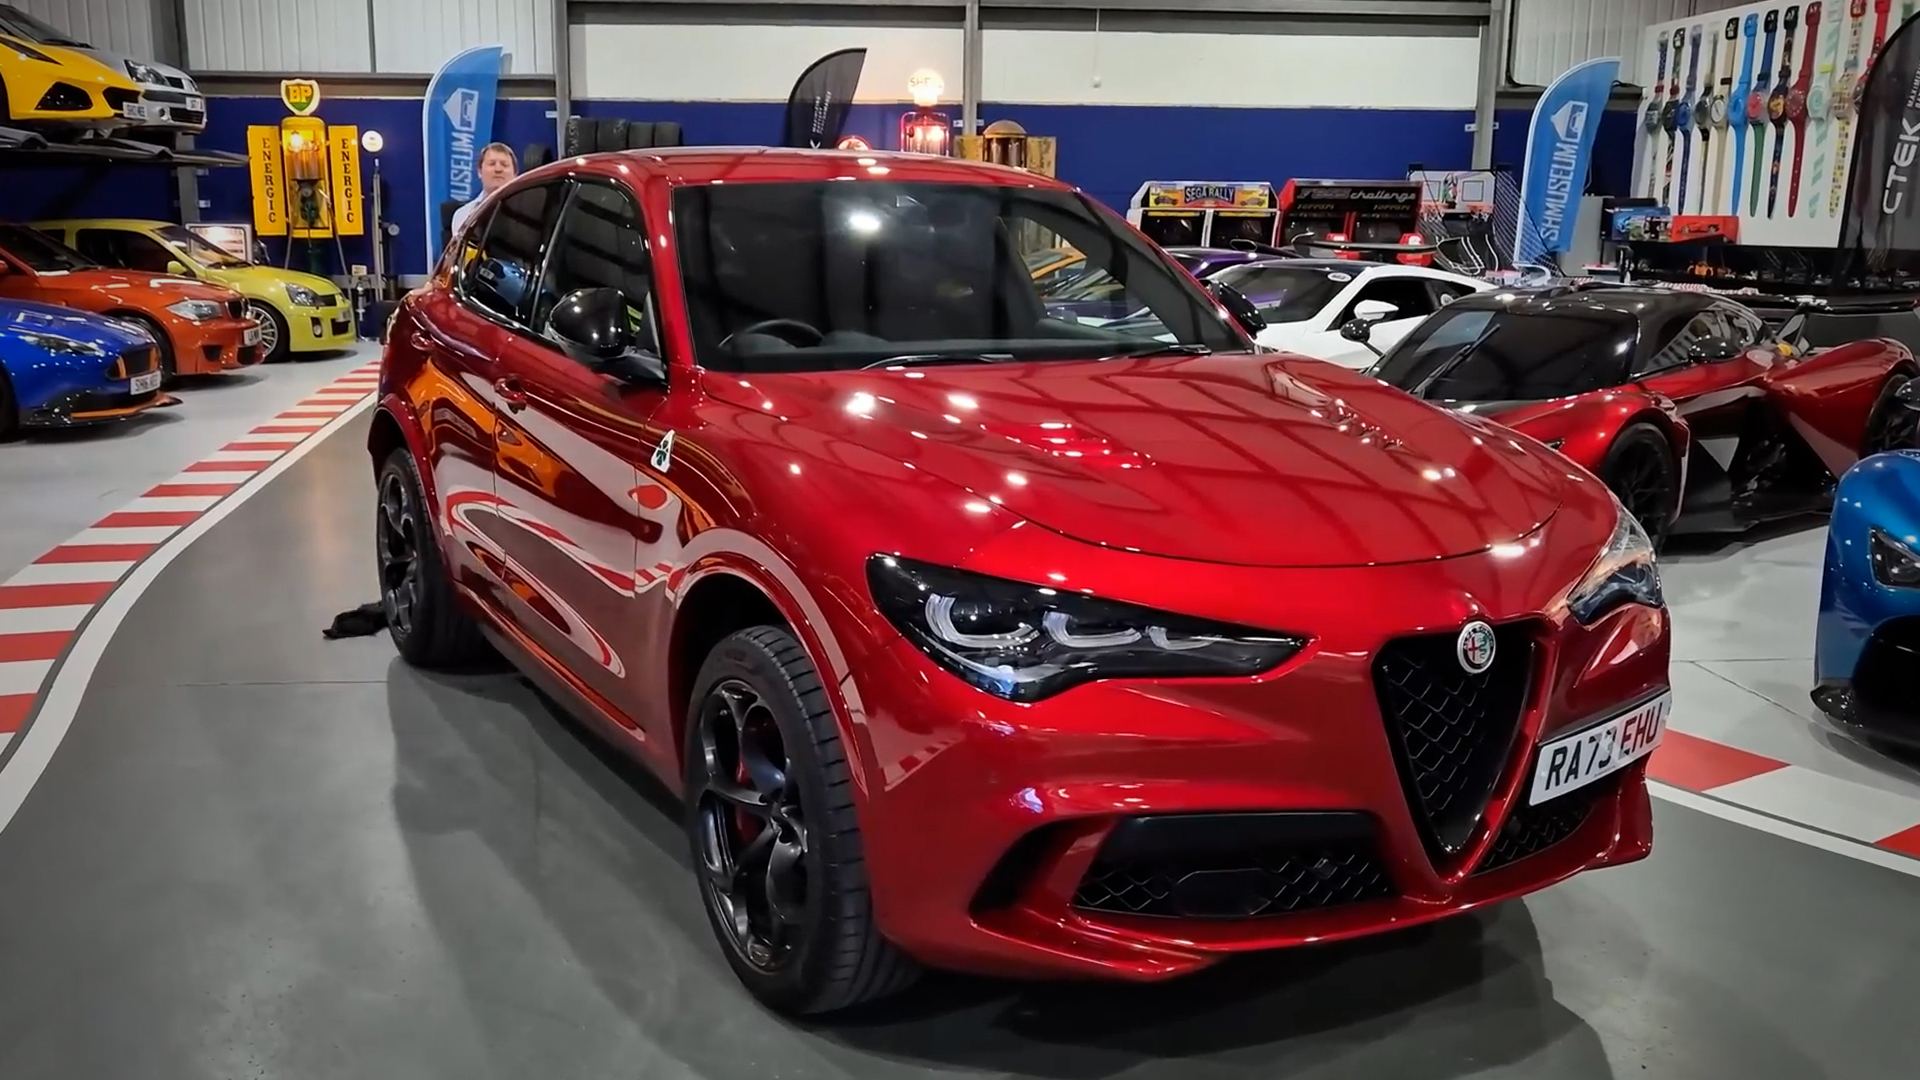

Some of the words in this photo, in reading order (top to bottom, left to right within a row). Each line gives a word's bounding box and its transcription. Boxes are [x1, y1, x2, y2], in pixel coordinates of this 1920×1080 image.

[288, 85, 312, 103] BP
[262, 137, 277, 223] ENERGIC
[341, 138, 355, 223] ENERGIC
[1185, 188, 1207, 202] SEGA
[1208, 187, 1235, 201] RALLY
[1350, 189, 1416, 203] challenge
[1540, 142, 1579, 241] SHMUSEUM
[1882, 116, 1920, 214] CTEK
[1545, 726, 1618, 791] RA73
[1620, 702, 1663, 758] EHU
